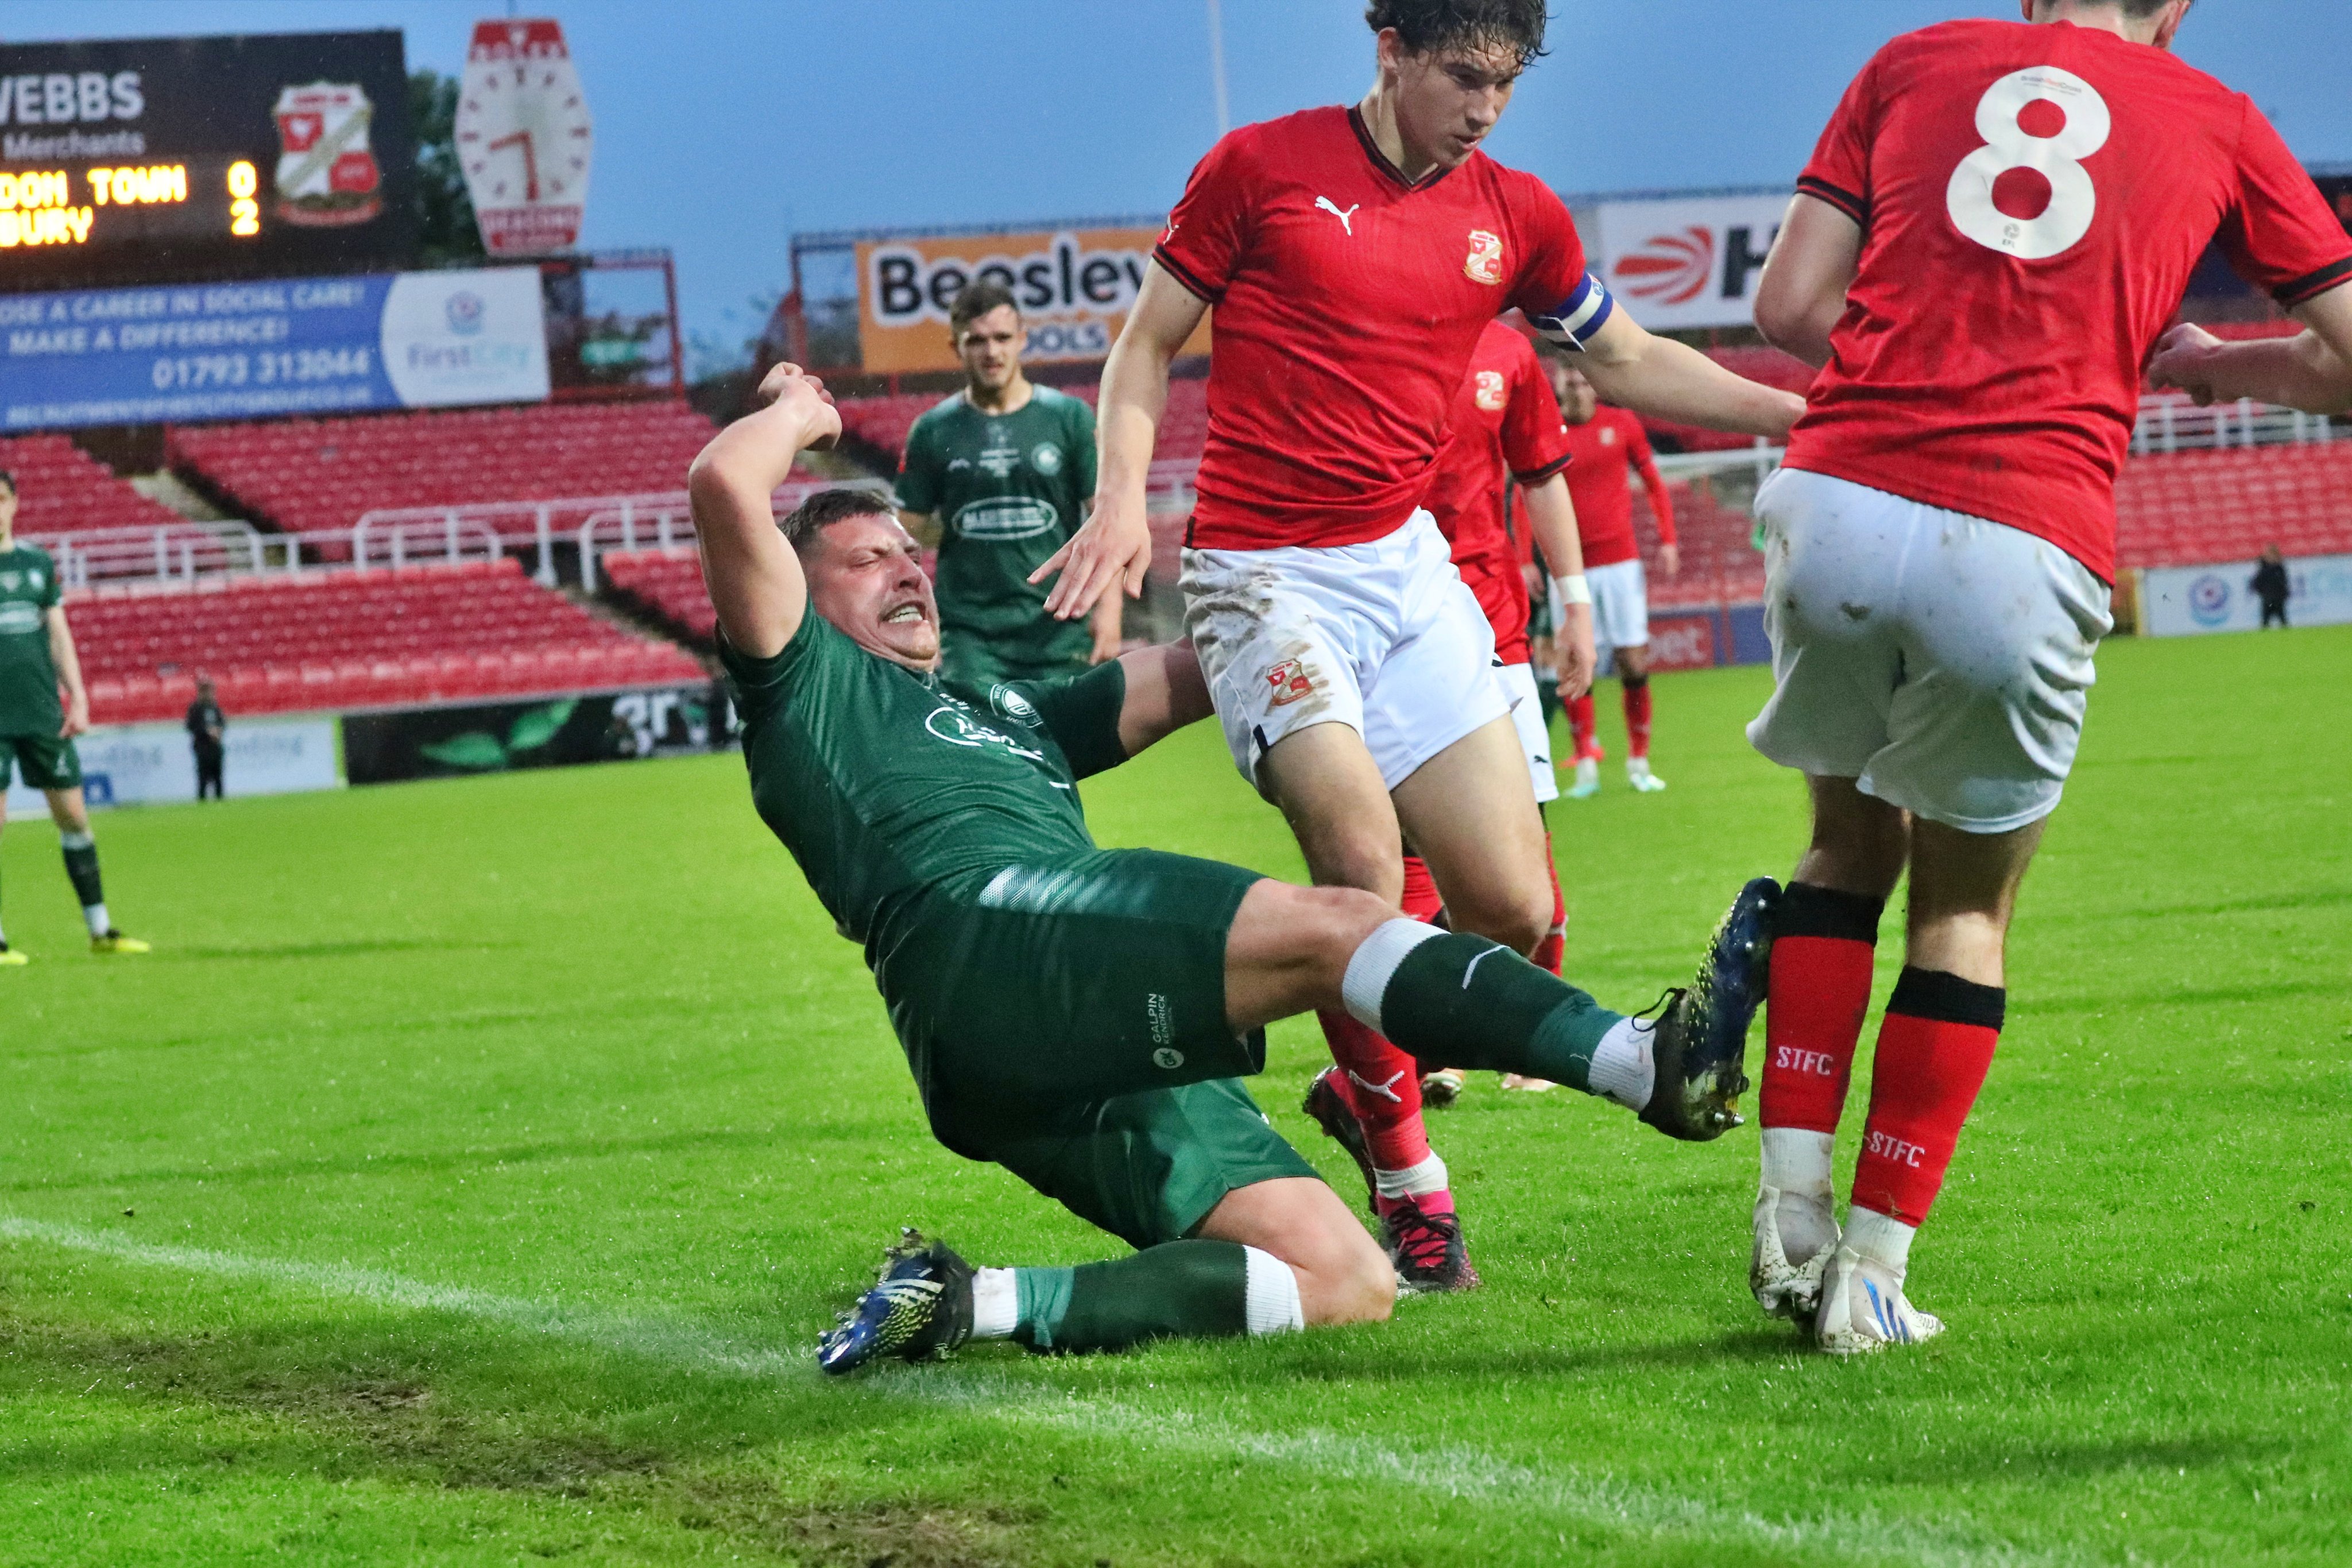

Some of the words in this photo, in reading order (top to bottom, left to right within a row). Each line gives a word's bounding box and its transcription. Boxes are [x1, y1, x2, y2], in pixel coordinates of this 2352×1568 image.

[87, 164, 187, 205] TOWN
[227, 160, 256, 199] 0
[1946, 65, 2111, 260] 8
[230, 197, 260, 235] 2
[877, 243, 1143, 315] Beesle
[49, 297, 67, 321] A
[71, 292, 167, 319] CAREER
[174, 290, 200, 313] IN
[204, 287, 285, 314] SOCIAL
[9, 327, 88, 356] MAKE
[94, 326, 114, 350] A
[152, 353, 249, 390] 01793
[256, 348, 370, 384] 313044
[1148, 993, 1162, 1043] GALPIN
[1158, 994, 1170, 1044] KENDRICK
[1776, 1046, 1833, 1075] STFC
[1869, 1131, 1925, 1168] STFC
